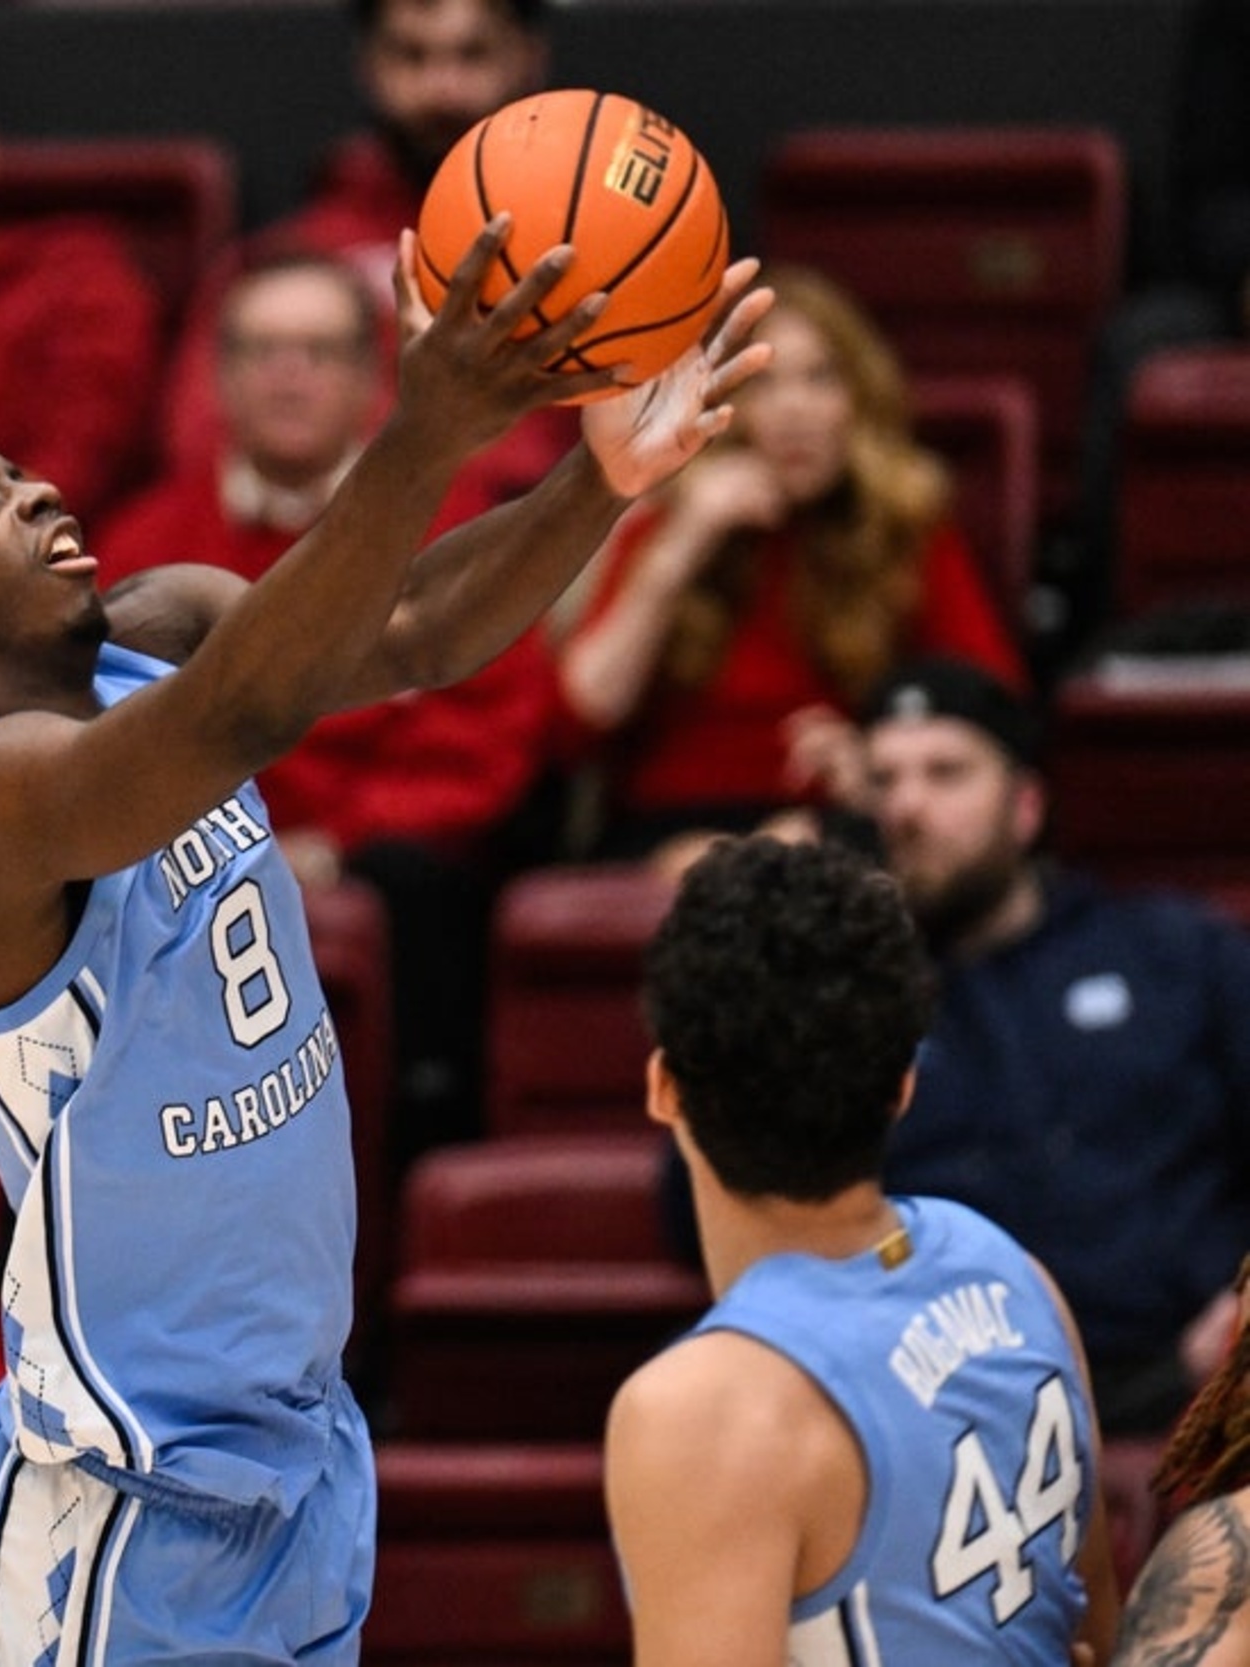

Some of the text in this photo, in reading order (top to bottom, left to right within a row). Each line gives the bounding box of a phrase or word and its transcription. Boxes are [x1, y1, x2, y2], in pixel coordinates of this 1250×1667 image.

[210, 877, 292, 1050] 8
[159, 1007, 338, 1158] CAROLINA
[931, 1370, 1083, 1629] 44
